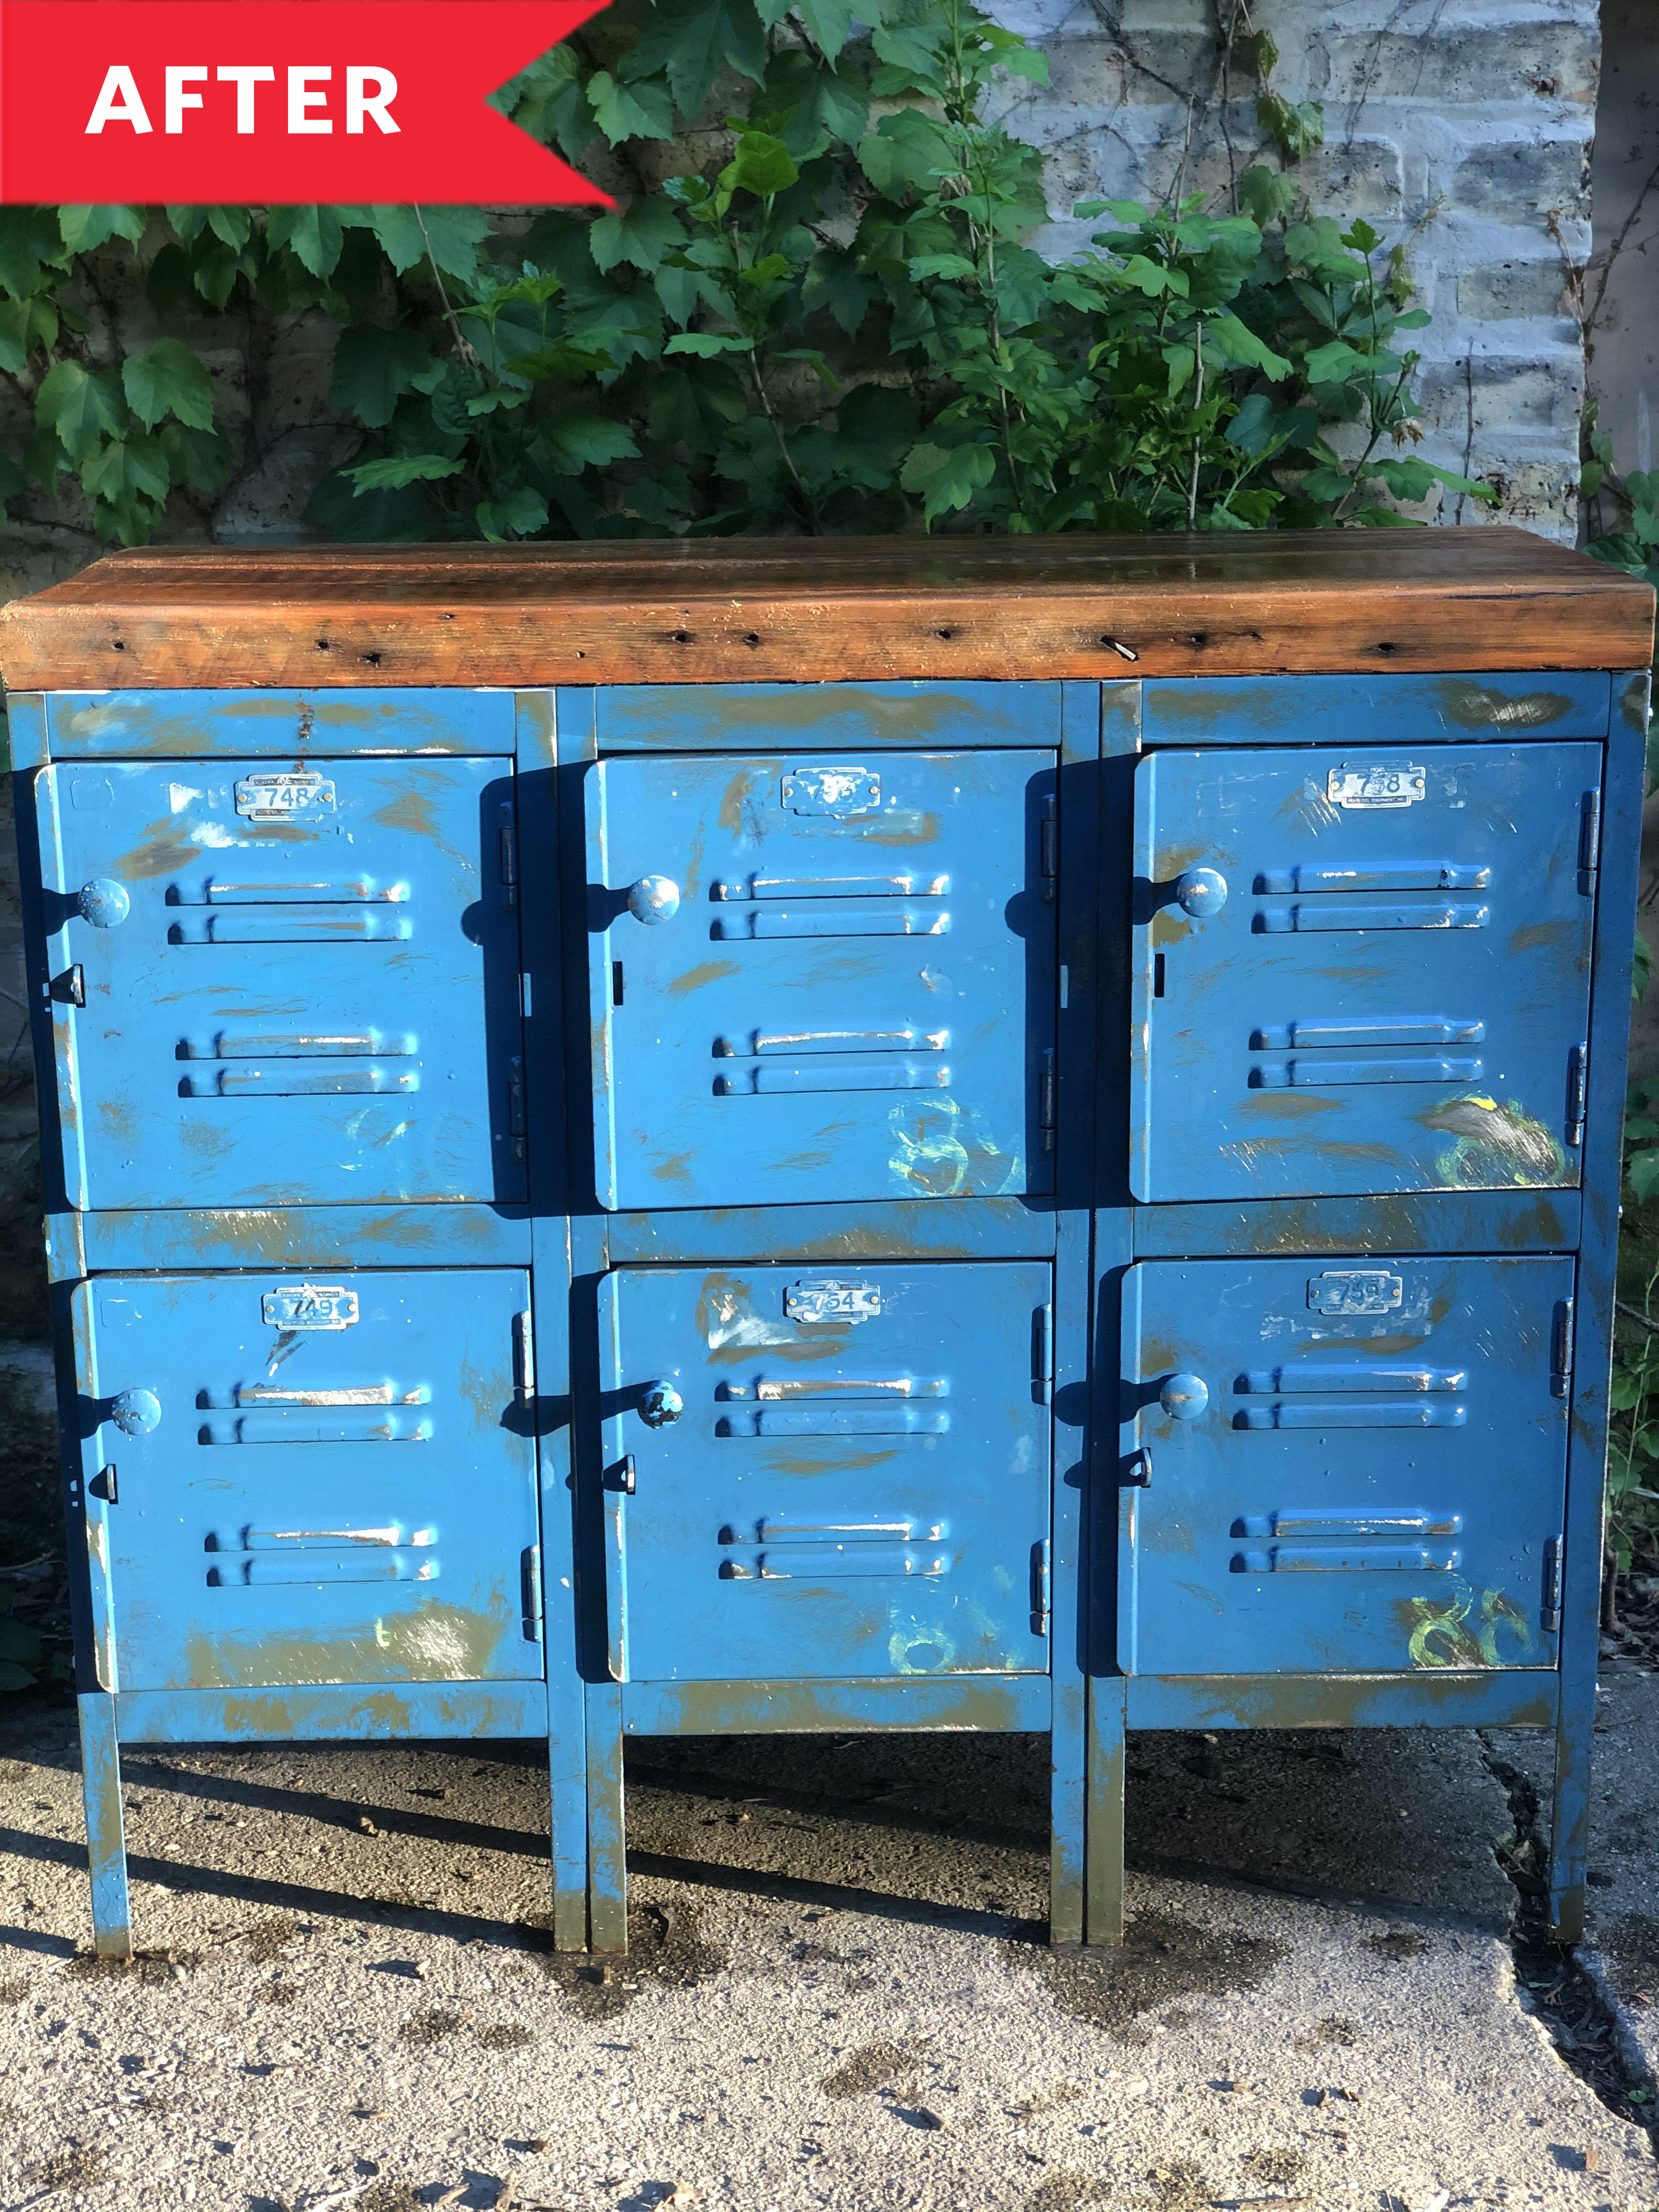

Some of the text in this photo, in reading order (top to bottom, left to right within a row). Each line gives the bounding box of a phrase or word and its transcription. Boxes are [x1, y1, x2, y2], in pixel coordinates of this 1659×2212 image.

[264, 788, 309, 807] 748
[290, 1299, 332, 1318] 749
[811, 1291, 855, 1311] 754
